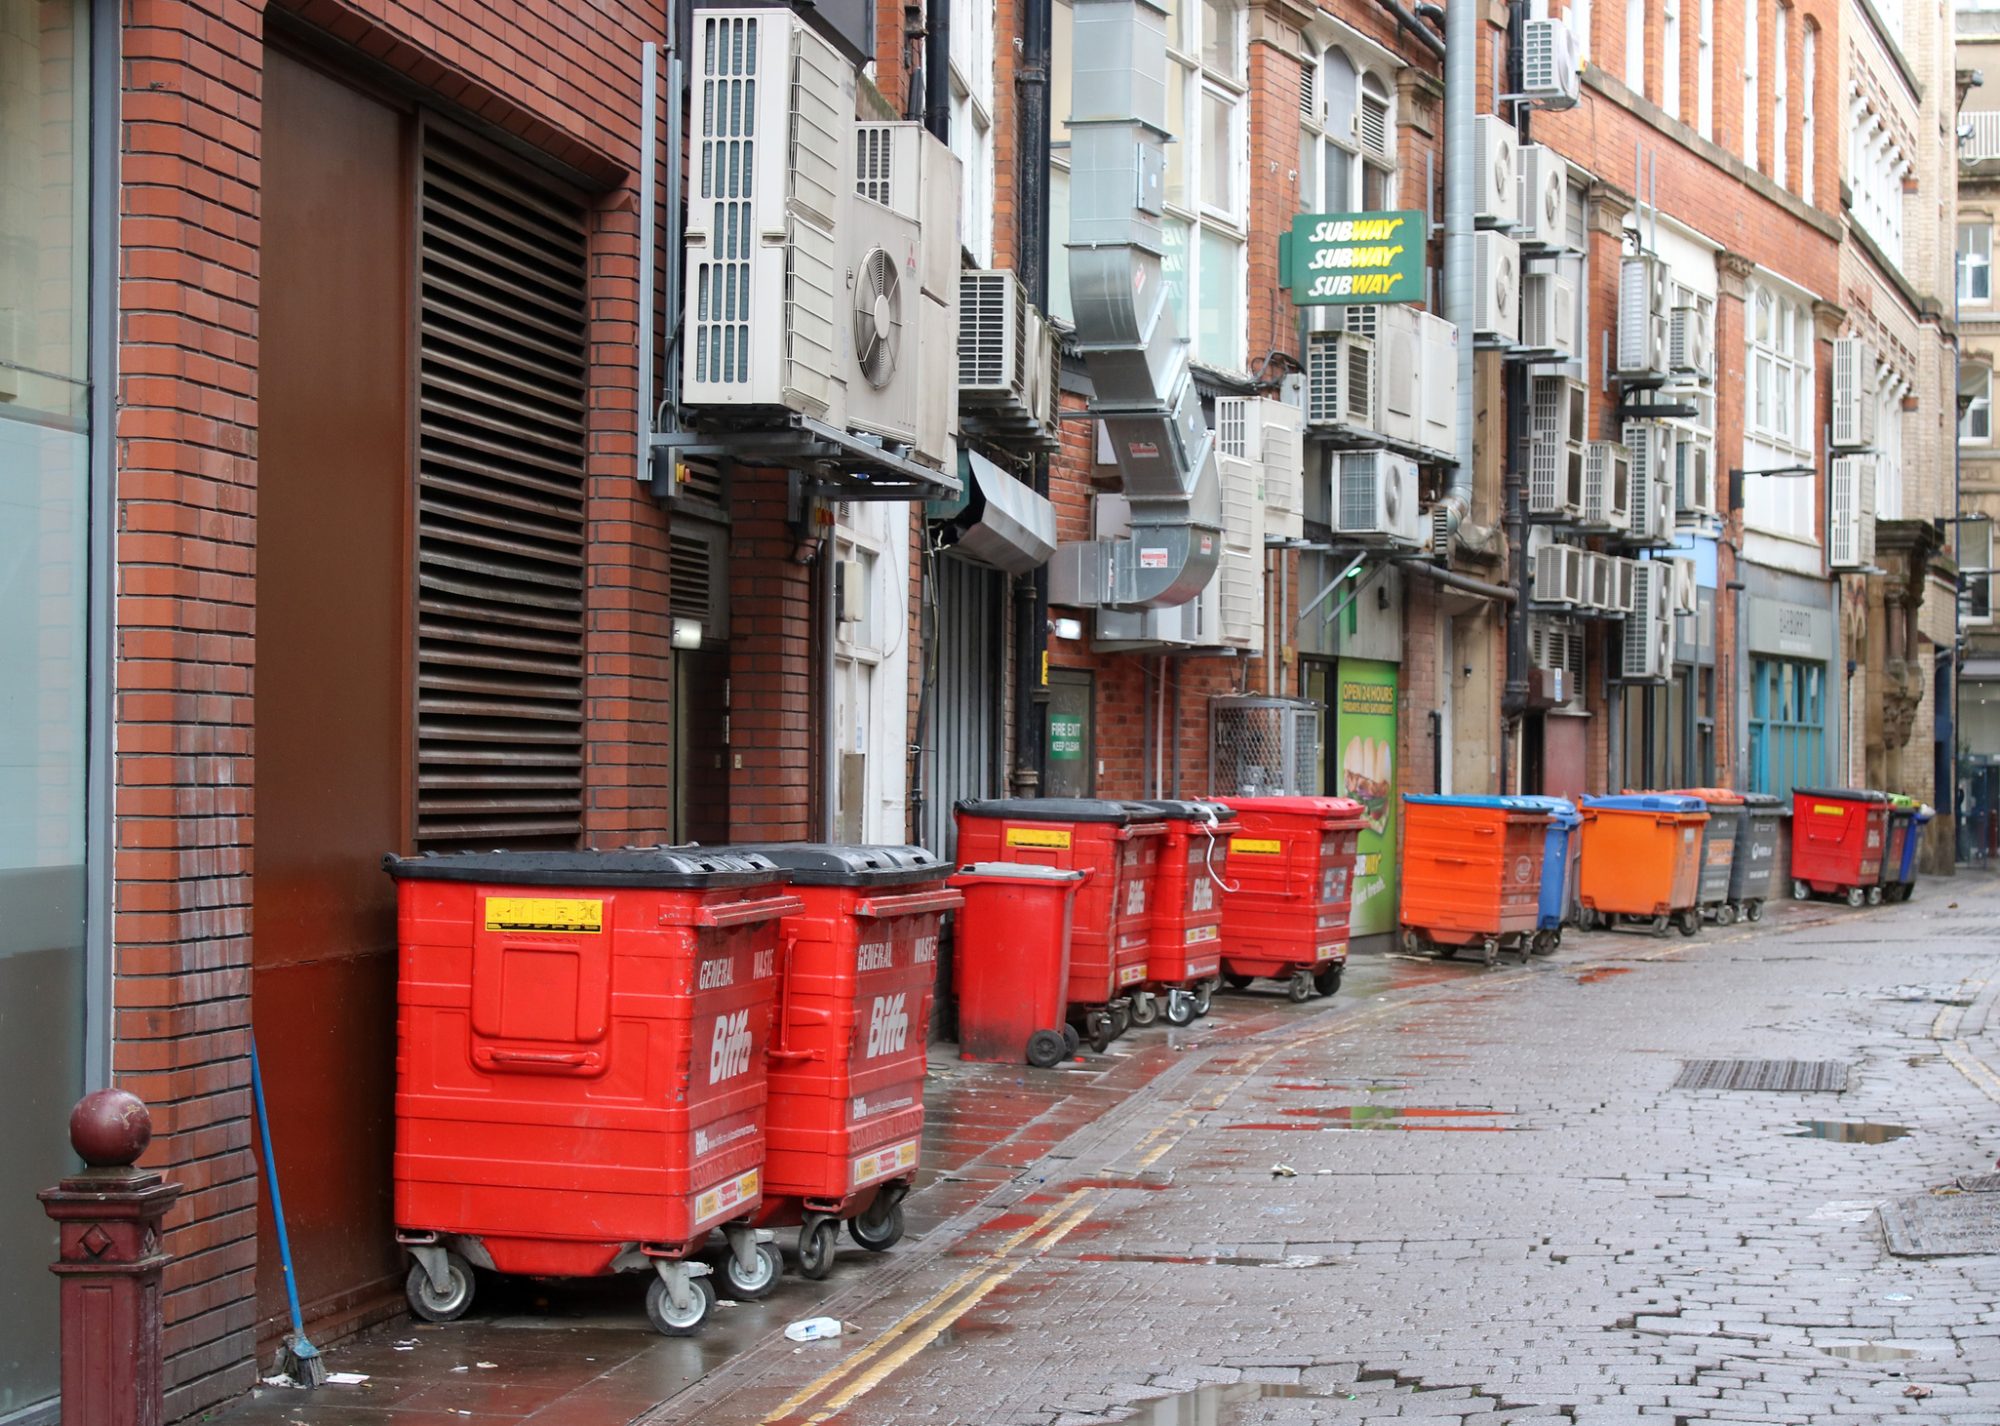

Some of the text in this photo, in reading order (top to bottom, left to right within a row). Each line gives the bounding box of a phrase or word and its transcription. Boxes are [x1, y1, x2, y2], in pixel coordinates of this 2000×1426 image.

[1308, 218, 1404, 242] SUBWAY
[1308, 245, 1404, 270] SUBWAY
[1307, 272, 1404, 297] SUBWAY
[1343, 683, 1361, 700] OPEN
[1371, 686, 1393, 702] HOURS
[1051, 722, 1081, 737] FIRE EXIT
[1052, 741, 1065, 752] KEEP
[1354, 853, 1382, 877] UBWAY
[858, 941, 893, 972] GENERAL
[700, 949, 774, 990] GENERAL WASTE
[867, 992, 909, 1059] Biffa
[709, 1008, 753, 1086] Biffa
